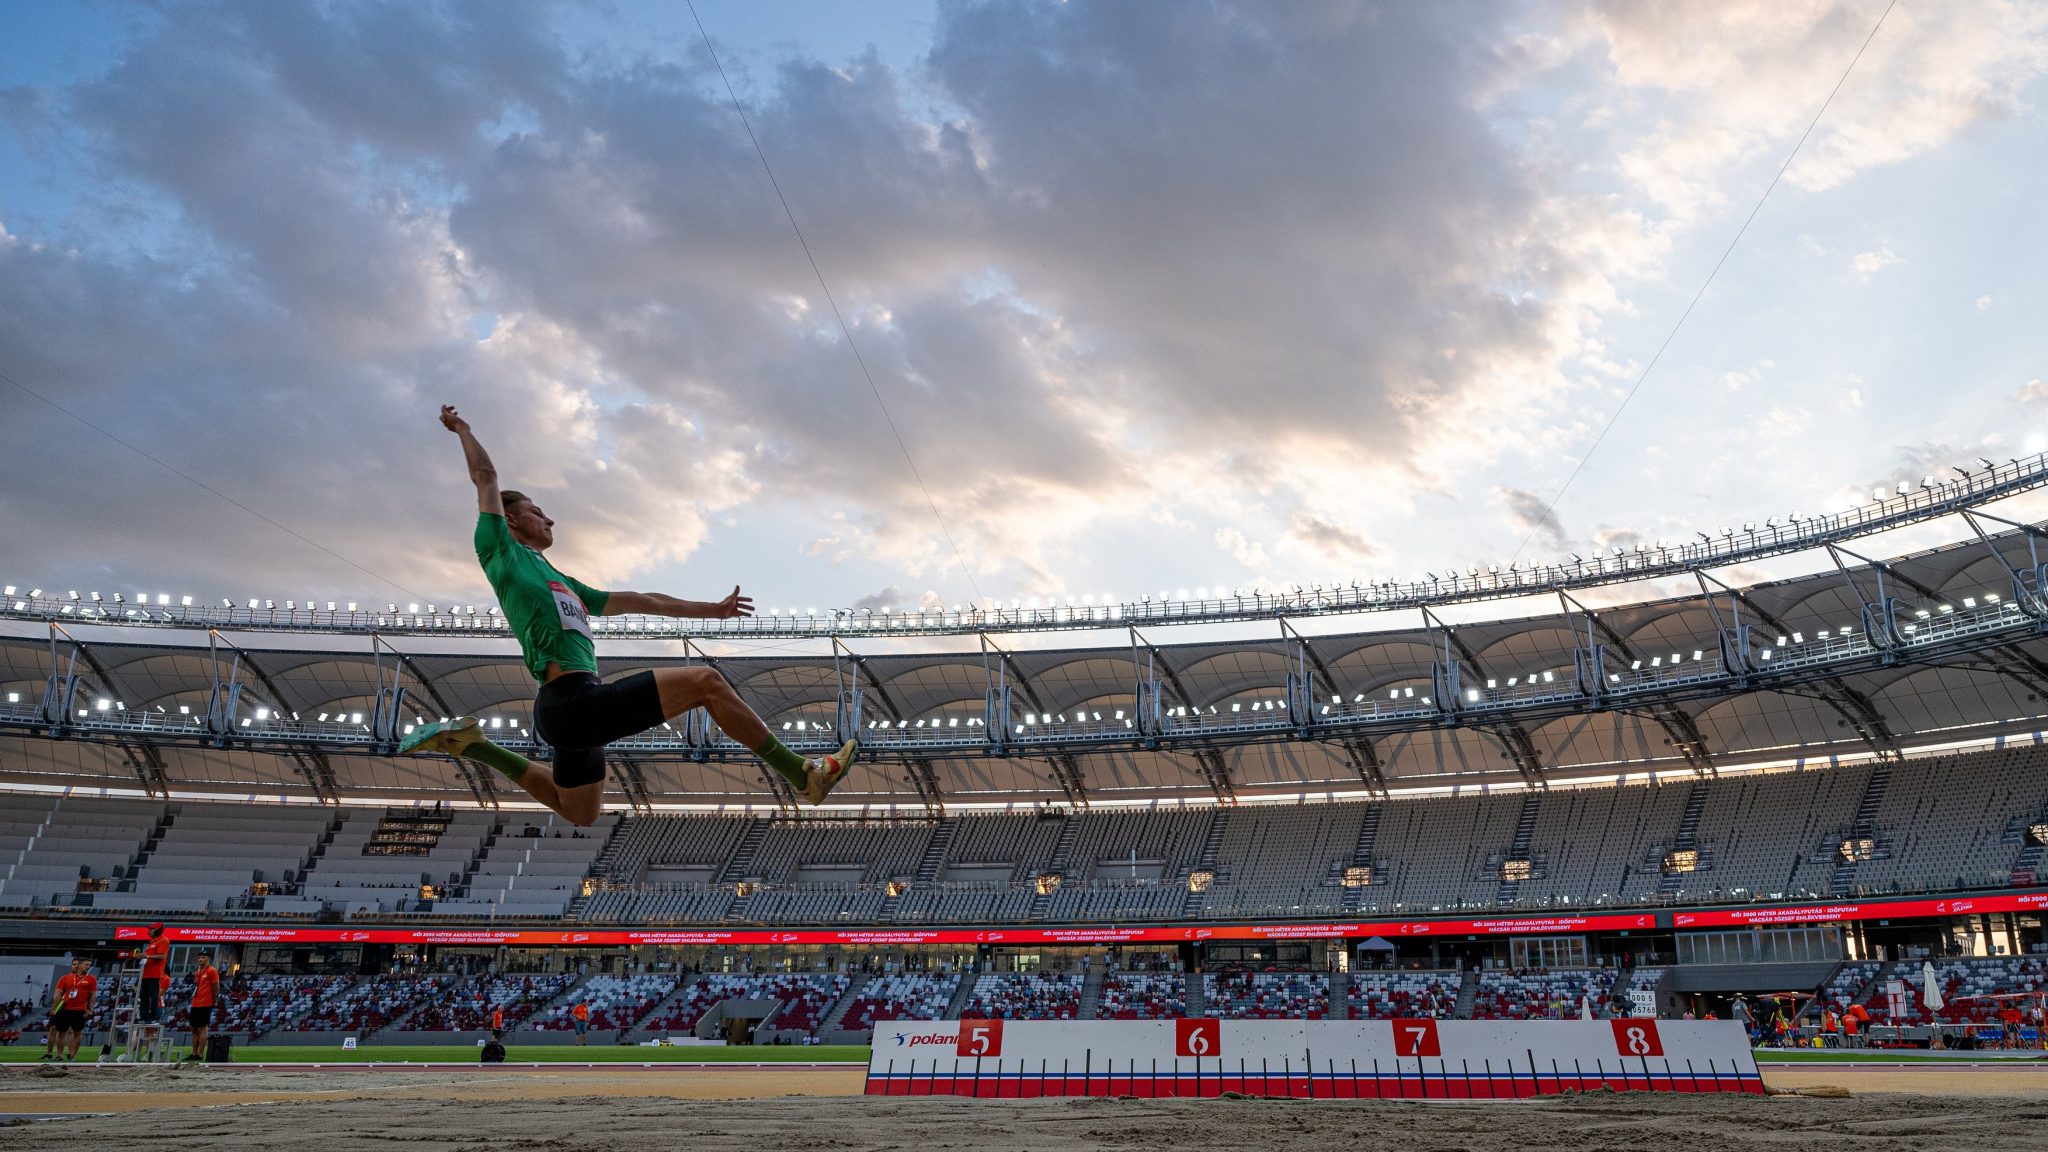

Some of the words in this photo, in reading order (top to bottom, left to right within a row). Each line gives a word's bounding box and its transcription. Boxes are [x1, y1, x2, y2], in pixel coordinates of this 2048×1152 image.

[970, 1028, 989, 1054] 5
[1189, 1027, 1208, 1054] 6
[1405, 1027, 1426, 1054] 7
[1627, 1027, 1649, 1054] 8
